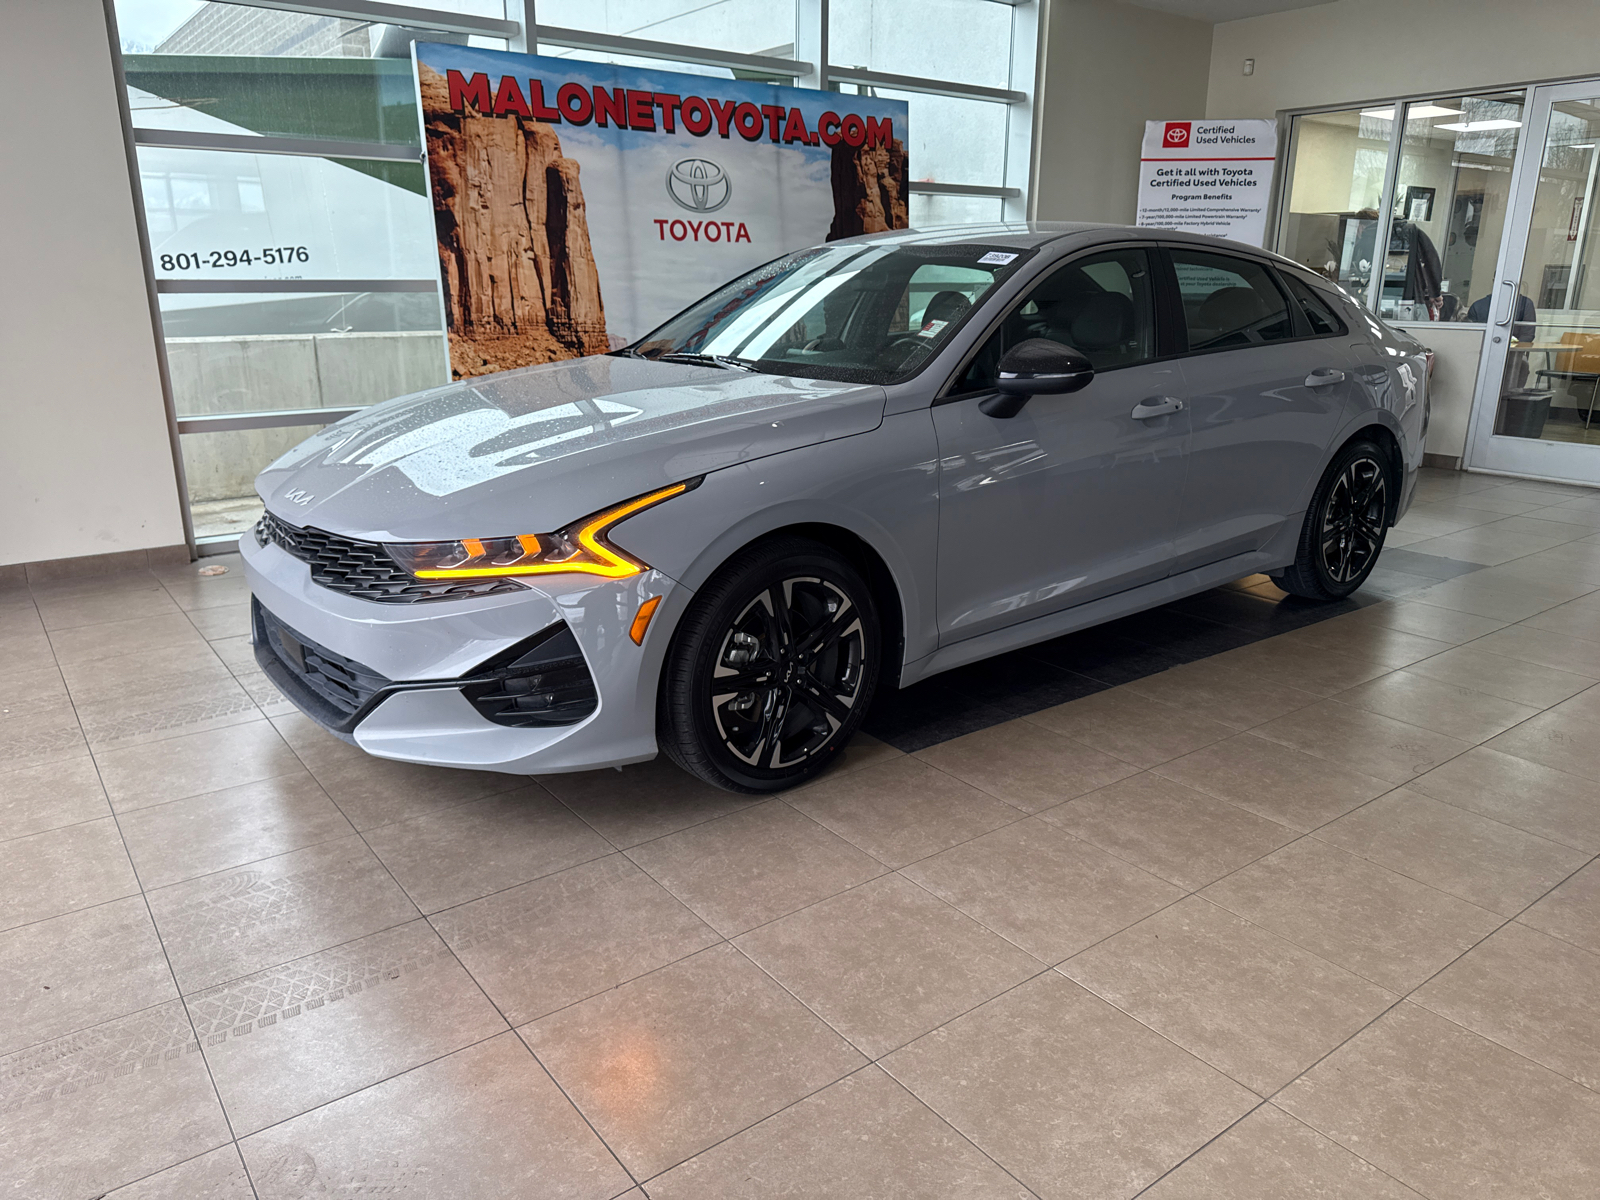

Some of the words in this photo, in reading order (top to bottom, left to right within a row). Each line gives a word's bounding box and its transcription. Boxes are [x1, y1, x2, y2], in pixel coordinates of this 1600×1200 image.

[446, 68, 894, 151] MALONETOYOTA.COM
[1197, 126, 1235, 134] Certified
[1196, 136, 1218, 144] Used
[1220, 136, 1256, 144] Vehicles
[1156, 168, 1174, 176] Get
[1175, 168, 1182, 176] it
[1184, 168, 1196, 176] all
[1198, 168, 1220, 176] with
[1221, 168, 1253, 178] Toyota
[1150, 179, 1191, 187] Certified
[1193, 179, 1217, 187] Used
[1218, 179, 1257, 187] Vehicles
[653, 219, 752, 243] TOYOTA
[160, 246, 309, 271] 801-294-5176
